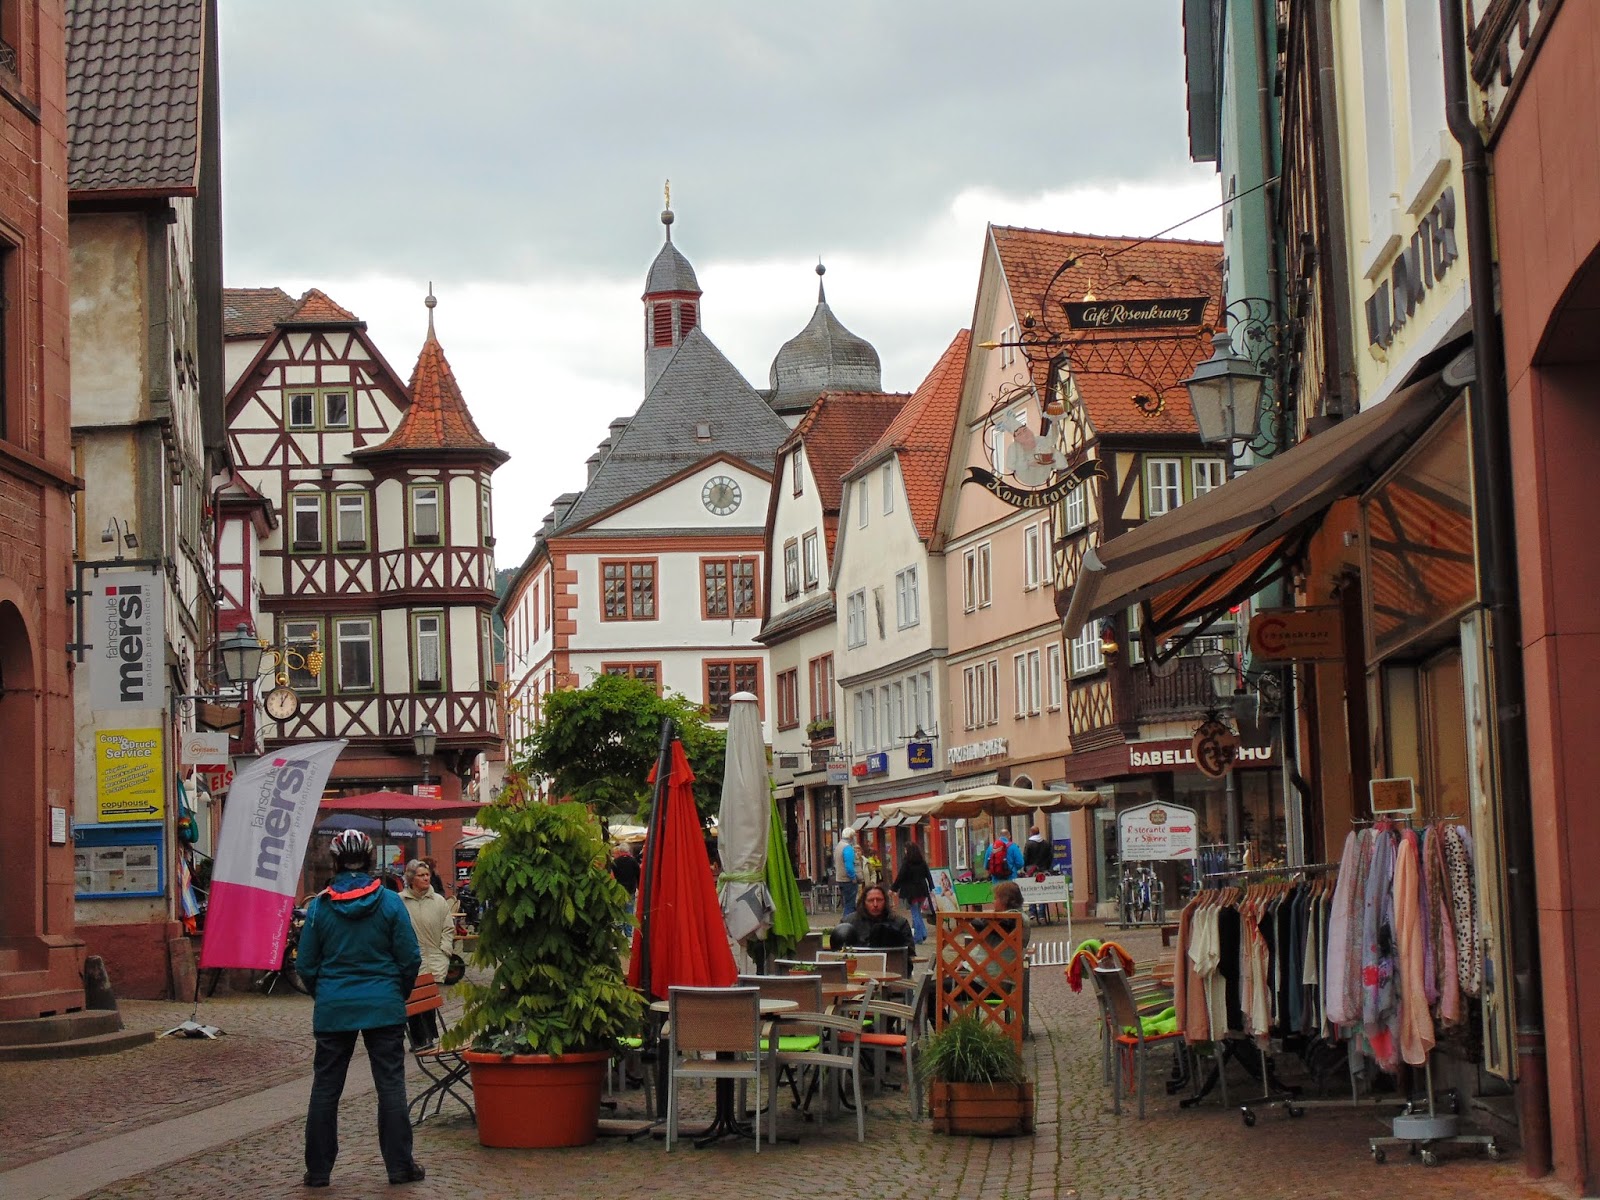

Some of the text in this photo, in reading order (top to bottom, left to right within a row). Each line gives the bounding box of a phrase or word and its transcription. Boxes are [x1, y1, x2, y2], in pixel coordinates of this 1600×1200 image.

[1082, 304, 1191, 326] Café Rosenkranz
[986, 473, 1082, 508] Konditorei
[105, 597, 118, 659] fahrschule
[110, 585, 143, 702] mersi
[100, 734, 125, 744] Copy
[129, 741, 157, 749] Druck
[106, 748, 152, 759] Service
[1130, 747, 1196, 767] ISABELL
[211, 770, 233, 791] EIS
[101, 799, 149, 808] copyhouse
[251, 767, 280, 829] fahrschule
[255, 759, 310, 881] mersi
[1127, 825, 1166, 834] Rstorante
